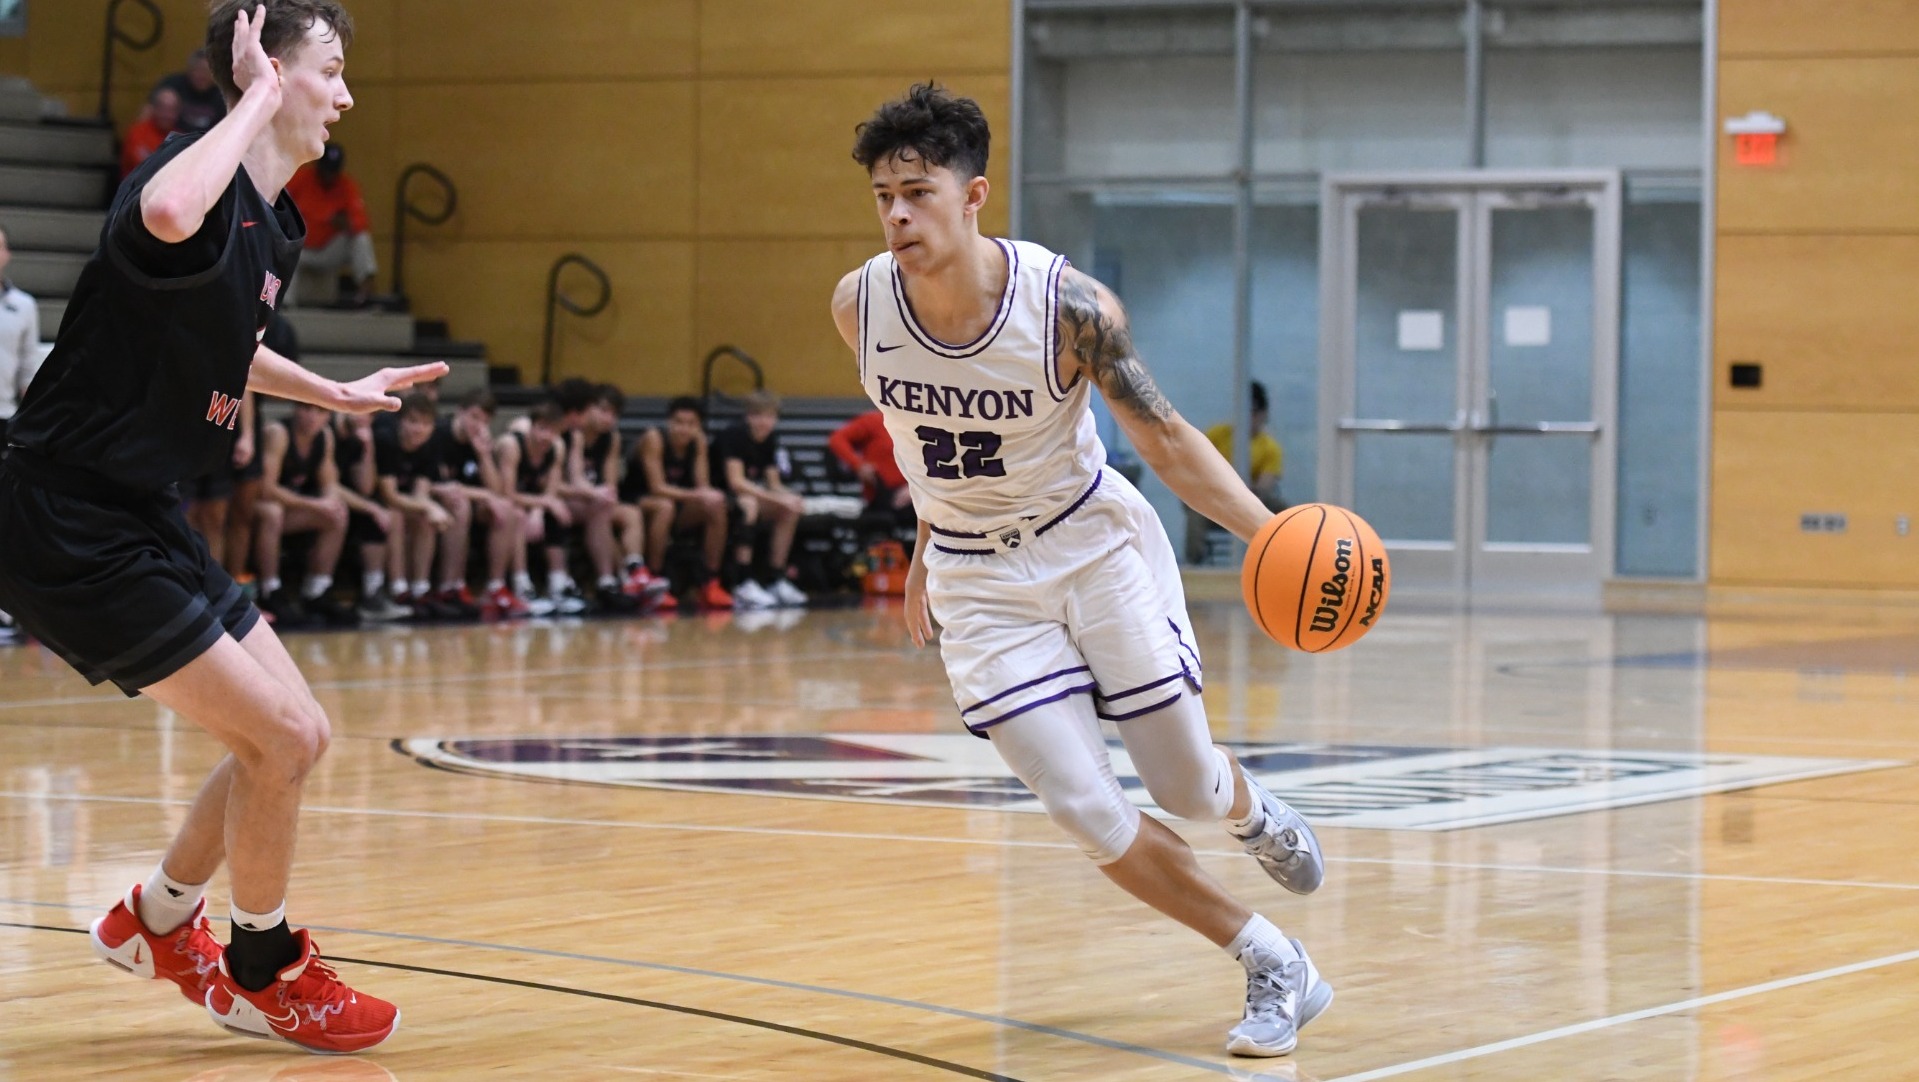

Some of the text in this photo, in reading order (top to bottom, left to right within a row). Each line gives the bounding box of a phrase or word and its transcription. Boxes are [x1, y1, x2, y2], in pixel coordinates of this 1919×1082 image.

[206, 390, 242, 430] W
[877, 375, 1033, 420] KENYON
[914, 425, 1006, 479] 22
[1309, 538, 1353, 632] Wilson
[1359, 558, 1384, 627] NCAA
